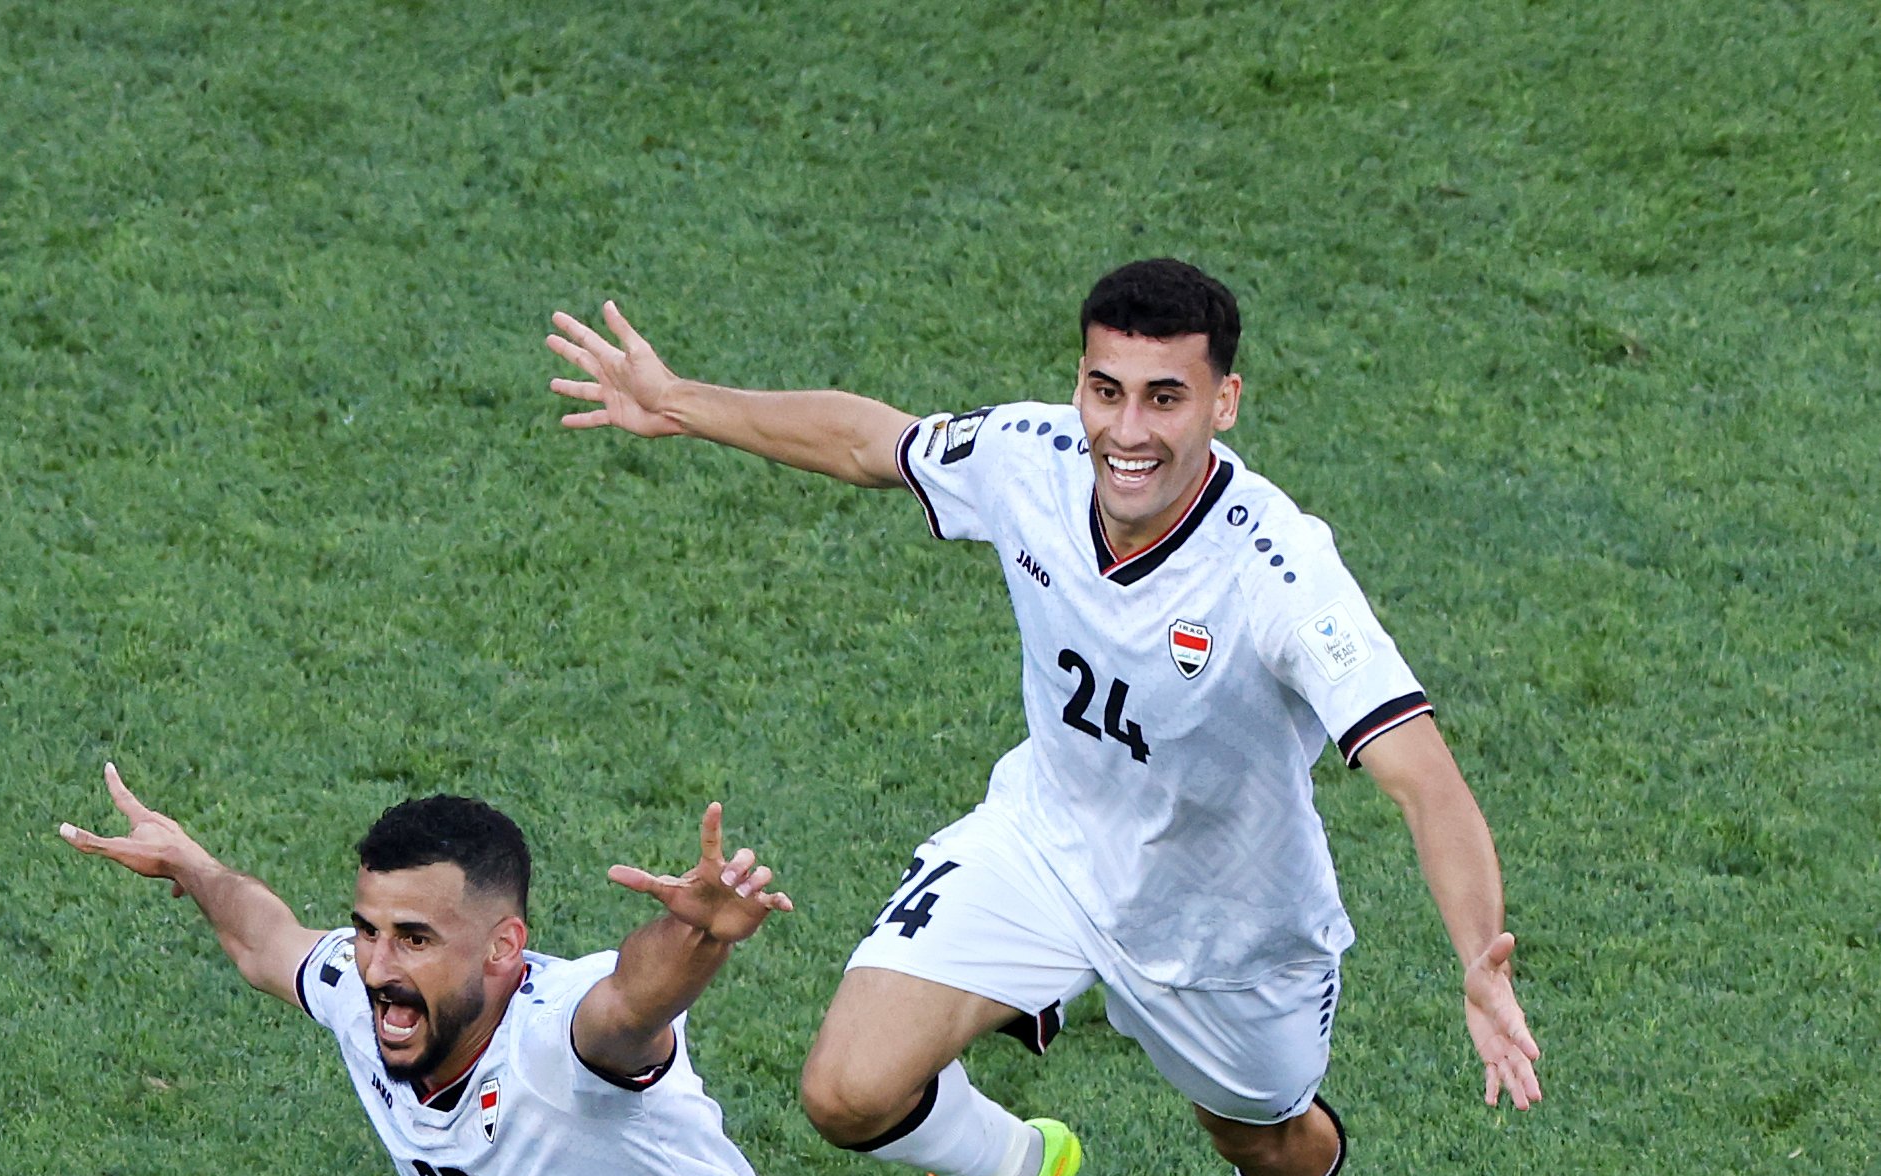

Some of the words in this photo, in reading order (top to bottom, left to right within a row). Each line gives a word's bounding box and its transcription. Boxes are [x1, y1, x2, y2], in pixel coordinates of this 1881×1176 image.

[1016, 549, 1050, 588] JAKO
[1179, 624, 1203, 636] IRAQ
[1332, 641, 1357, 664] PEACE
[1057, 649, 1152, 765] 24
[371, 1071, 393, 1110] JAKO
